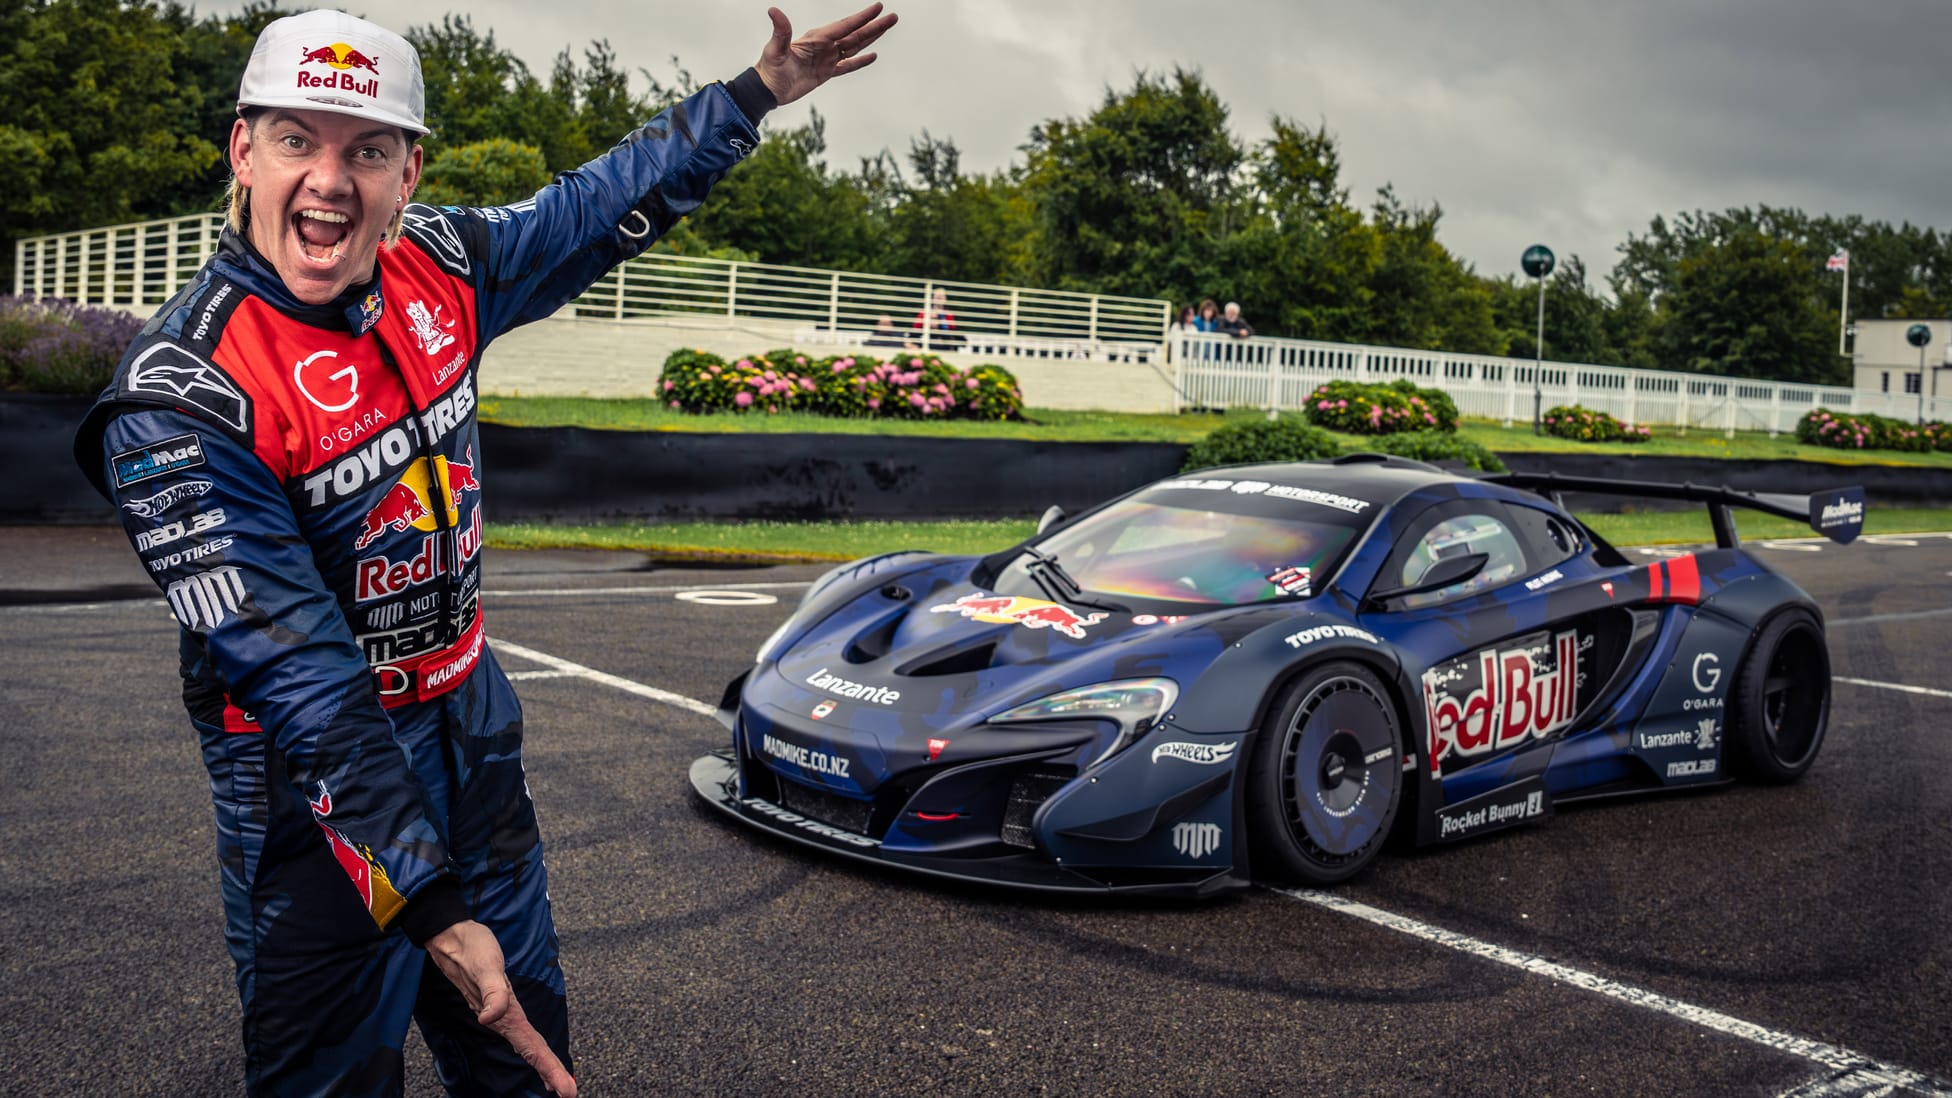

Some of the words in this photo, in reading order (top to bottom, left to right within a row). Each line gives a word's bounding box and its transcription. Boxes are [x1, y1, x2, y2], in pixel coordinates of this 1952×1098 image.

[297, 70, 336, 89] Red
[340, 76, 378, 98] Bull
[192, 311, 212, 340] TOYO
[208, 283, 233, 316] TIRES
[432, 351, 466, 387] Lanzante
[304, 427, 411, 507] TOYO
[406, 378, 475, 449] TIRES
[320, 408, 387, 451] O'GARA
[148, 550, 183, 573] TOYO
[180, 535, 234, 562] TIRES
[356, 531, 436, 600] Red
[1285, 625, 1336, 649] TOYO
[806, 667, 901, 706] Lanzante
[1495, 629, 1579, 753] Bull
[1682, 697, 1724, 711] O'GARA
[763, 733, 850, 778] MADMIKE.CO.NZ
[1640, 730, 1693, 749] Lanzante
[1441, 807, 1488, 835] Rocket
[1488, 800, 1527, 823] Bunny
